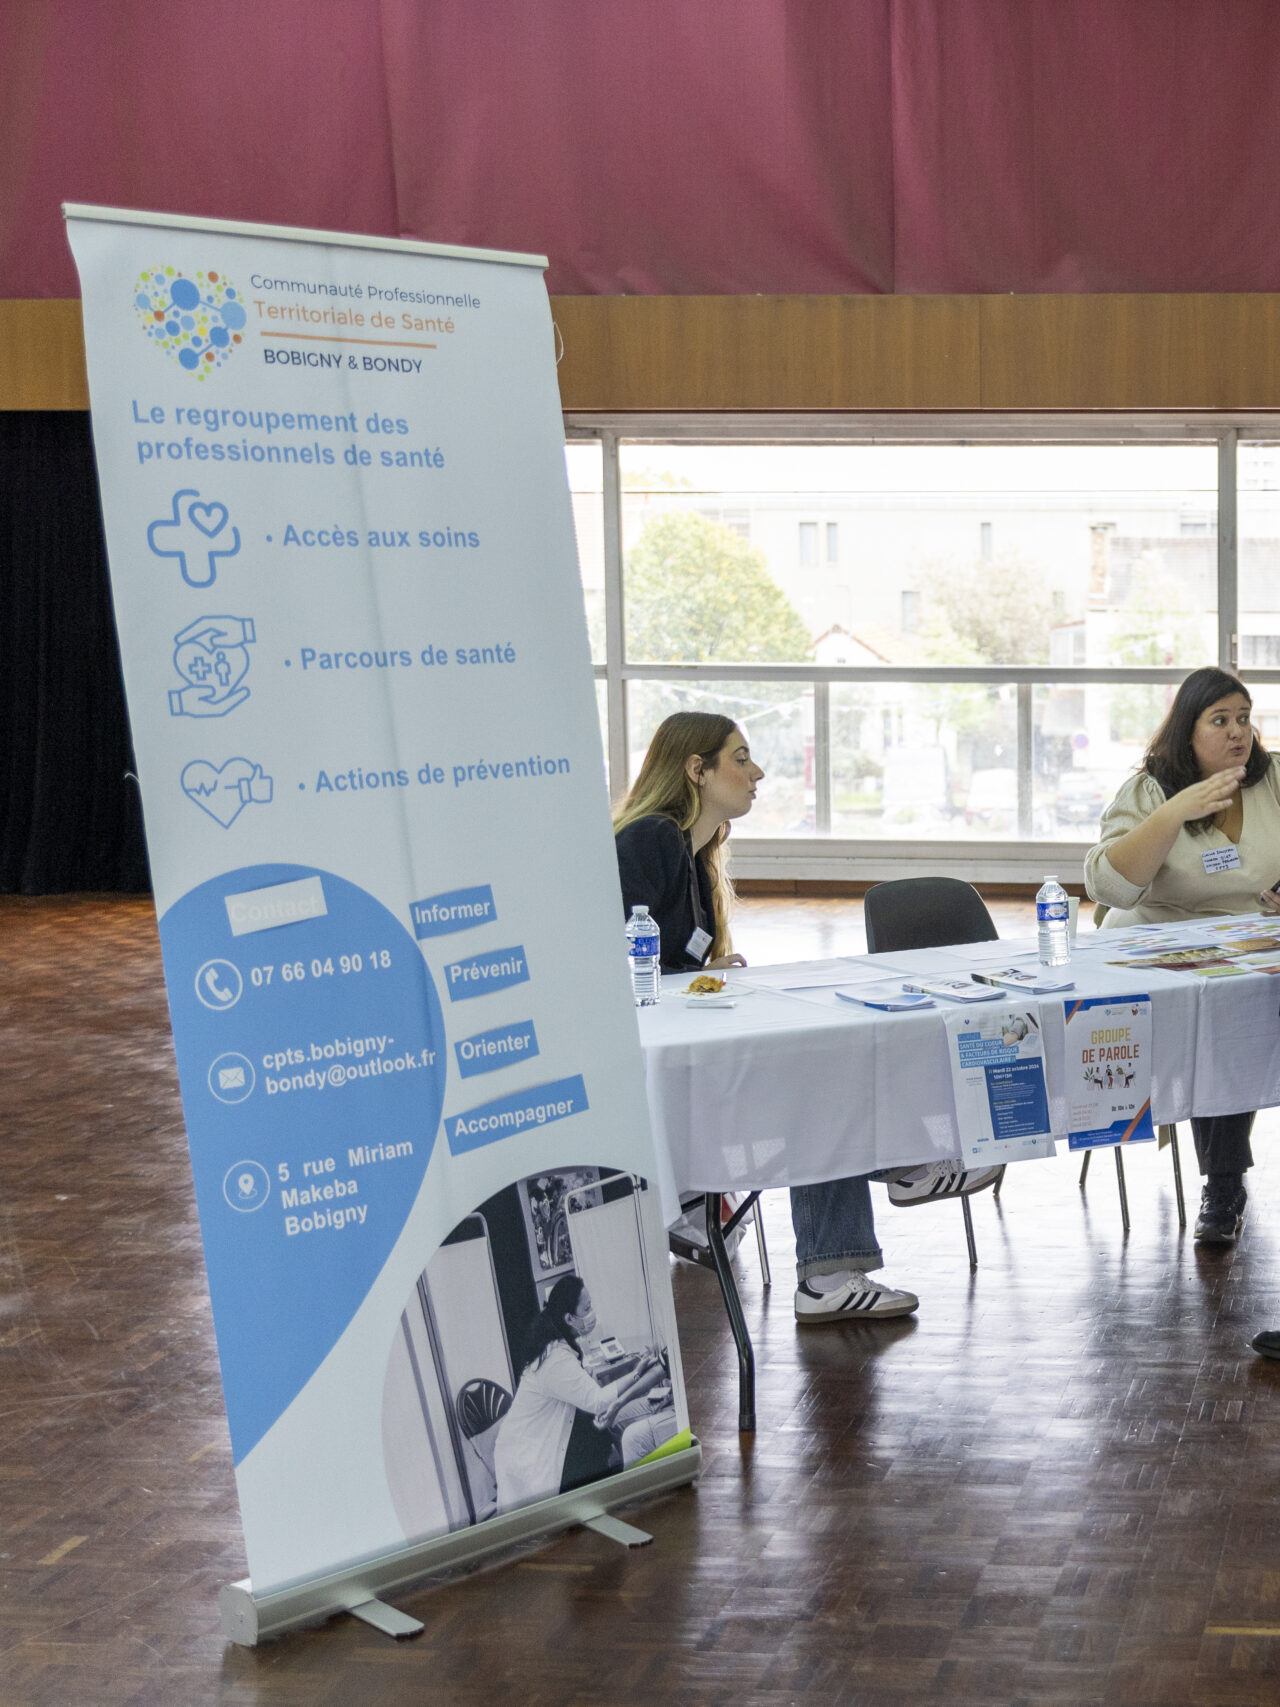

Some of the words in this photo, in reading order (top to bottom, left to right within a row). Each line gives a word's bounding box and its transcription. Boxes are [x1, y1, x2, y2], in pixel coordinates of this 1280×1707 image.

[251, 274, 363, 299] Communauté
[368, 286, 480, 309] Professionnelle
[254, 301, 364, 328] Territoriale
[371, 311, 395, 329] de
[402, 313, 455, 333] Santé
[264, 349, 342, 369] BOBIGNY
[348, 356, 358, 370] &
[363, 357, 422, 373] BONDY
[132, 400, 165, 424] Le
[176, 406, 358, 435] regroupement
[366, 413, 409, 434] des
[138, 438, 335, 465] professionnels
[345, 447, 371, 466] de
[381, 446, 445, 469] santé
[284, 524, 359, 547] Accès
[368, 531, 410, 547] aux
[419, 526, 480, 548] soins
[301, 648, 412, 670] Parcours
[421, 645, 448, 666] de
[456, 642, 516, 664] santé
[315, 768, 409, 793] Actions
[418, 762, 444, 785] de
[453, 755, 570, 786] prévention
[231, 896, 319, 922] Contact
[415, 901, 490, 925] Informer
[251, 967, 274, 986] 07
[282, 962, 305, 982] 66
[312, 959, 333, 978] 04
[340, 955, 362, 974] 90
[370, 951, 391, 969] 18
[451, 958, 523, 983] Prévenir
[263, 1033, 394, 1070] cpts.bobigny-
[461, 1033, 530, 1060] Orienter
[1091, 1028, 1131, 1044] GROUPE
[1082, 1049, 1095, 1063] DE
[1100, 1044, 1139, 1061] PAROLE
[266, 1049, 436, 1094] bondy@outlook.fr
[454, 1098, 573, 1136] Accompagner
[278, 1163, 289, 1181] 5
[303, 1157, 336, 1177] rue
[349, 1140, 413, 1167] Miriam
[281, 1180, 358, 1209] Makeba
[285, 1203, 367, 1237] Bobigny
